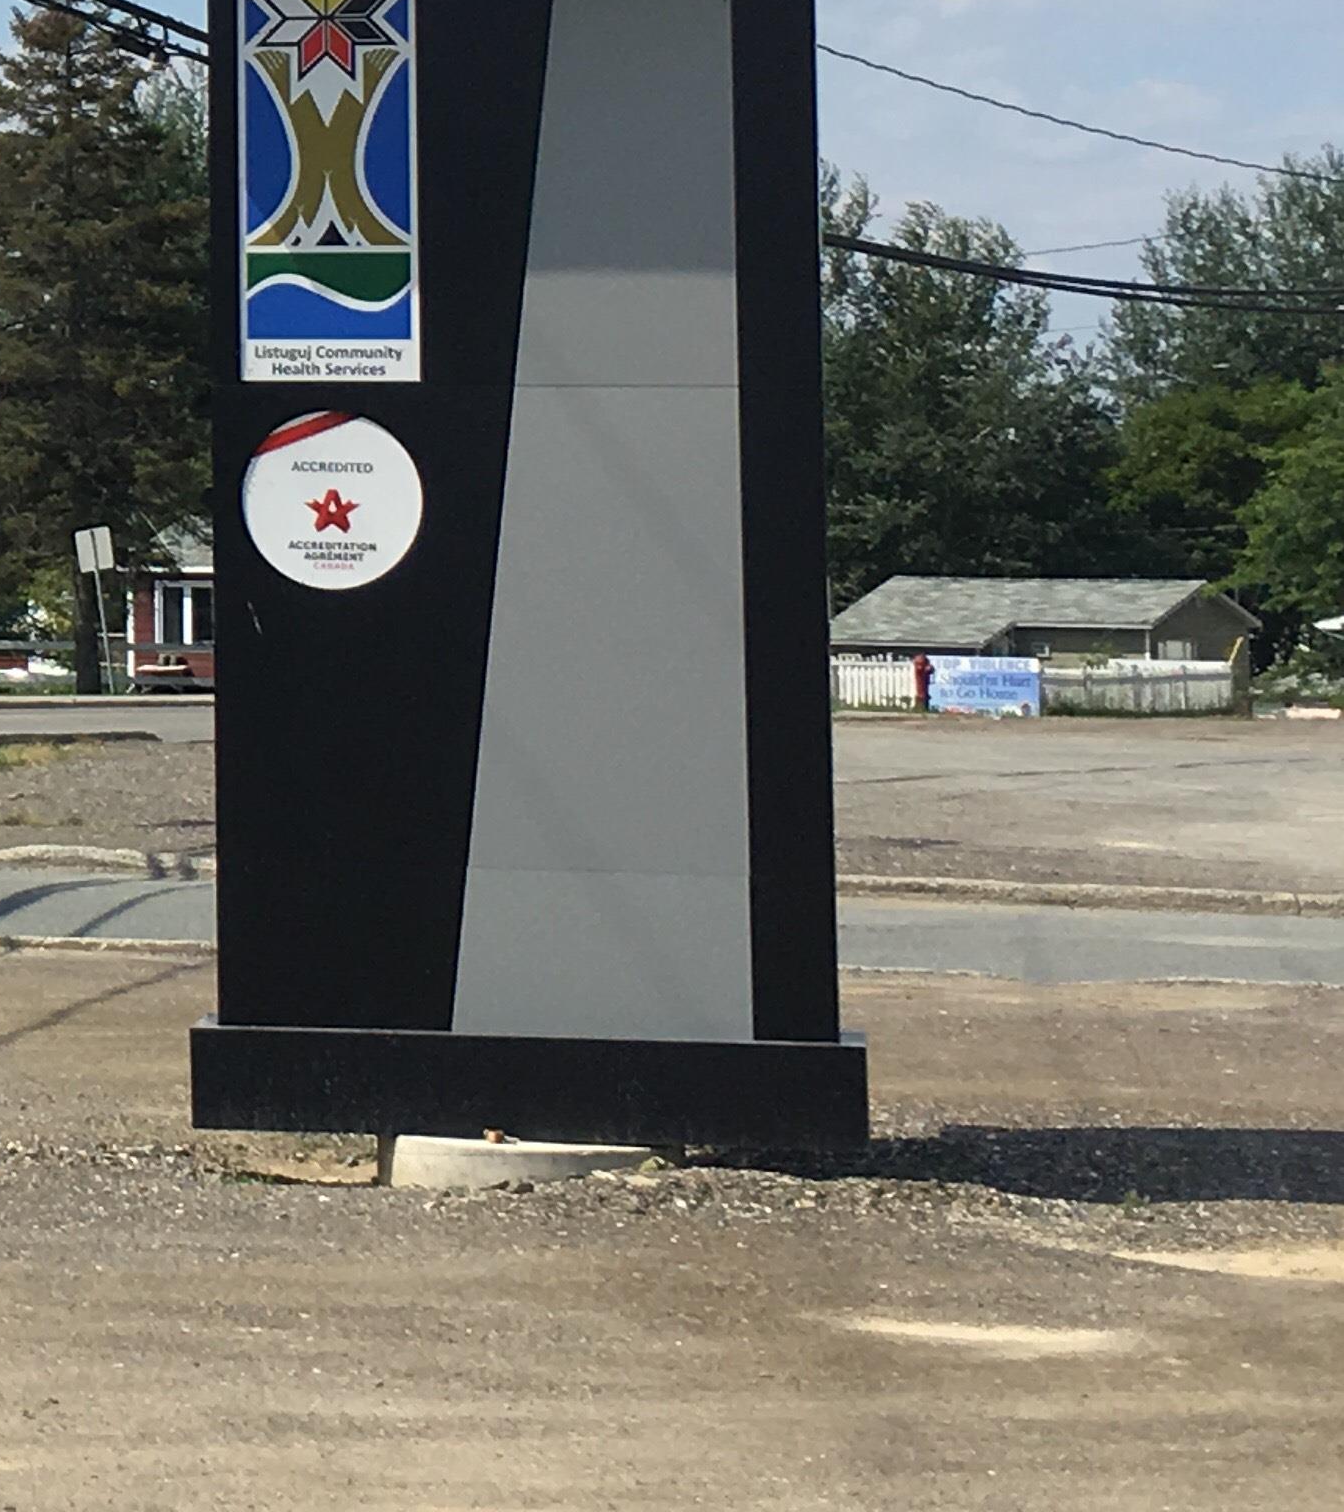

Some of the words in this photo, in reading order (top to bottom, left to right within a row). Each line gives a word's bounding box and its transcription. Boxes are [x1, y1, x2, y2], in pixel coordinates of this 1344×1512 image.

[255, 345, 311, 361] Listuguj
[316, 345, 402, 361] Community
[272, 362, 320, 375] Health
[325, 362, 386, 375] Services
[291, 461, 373, 473] ACCREDITED
[288, 540, 376, 551] ACCREDITATION
[956, 687, 976, 698] Go
